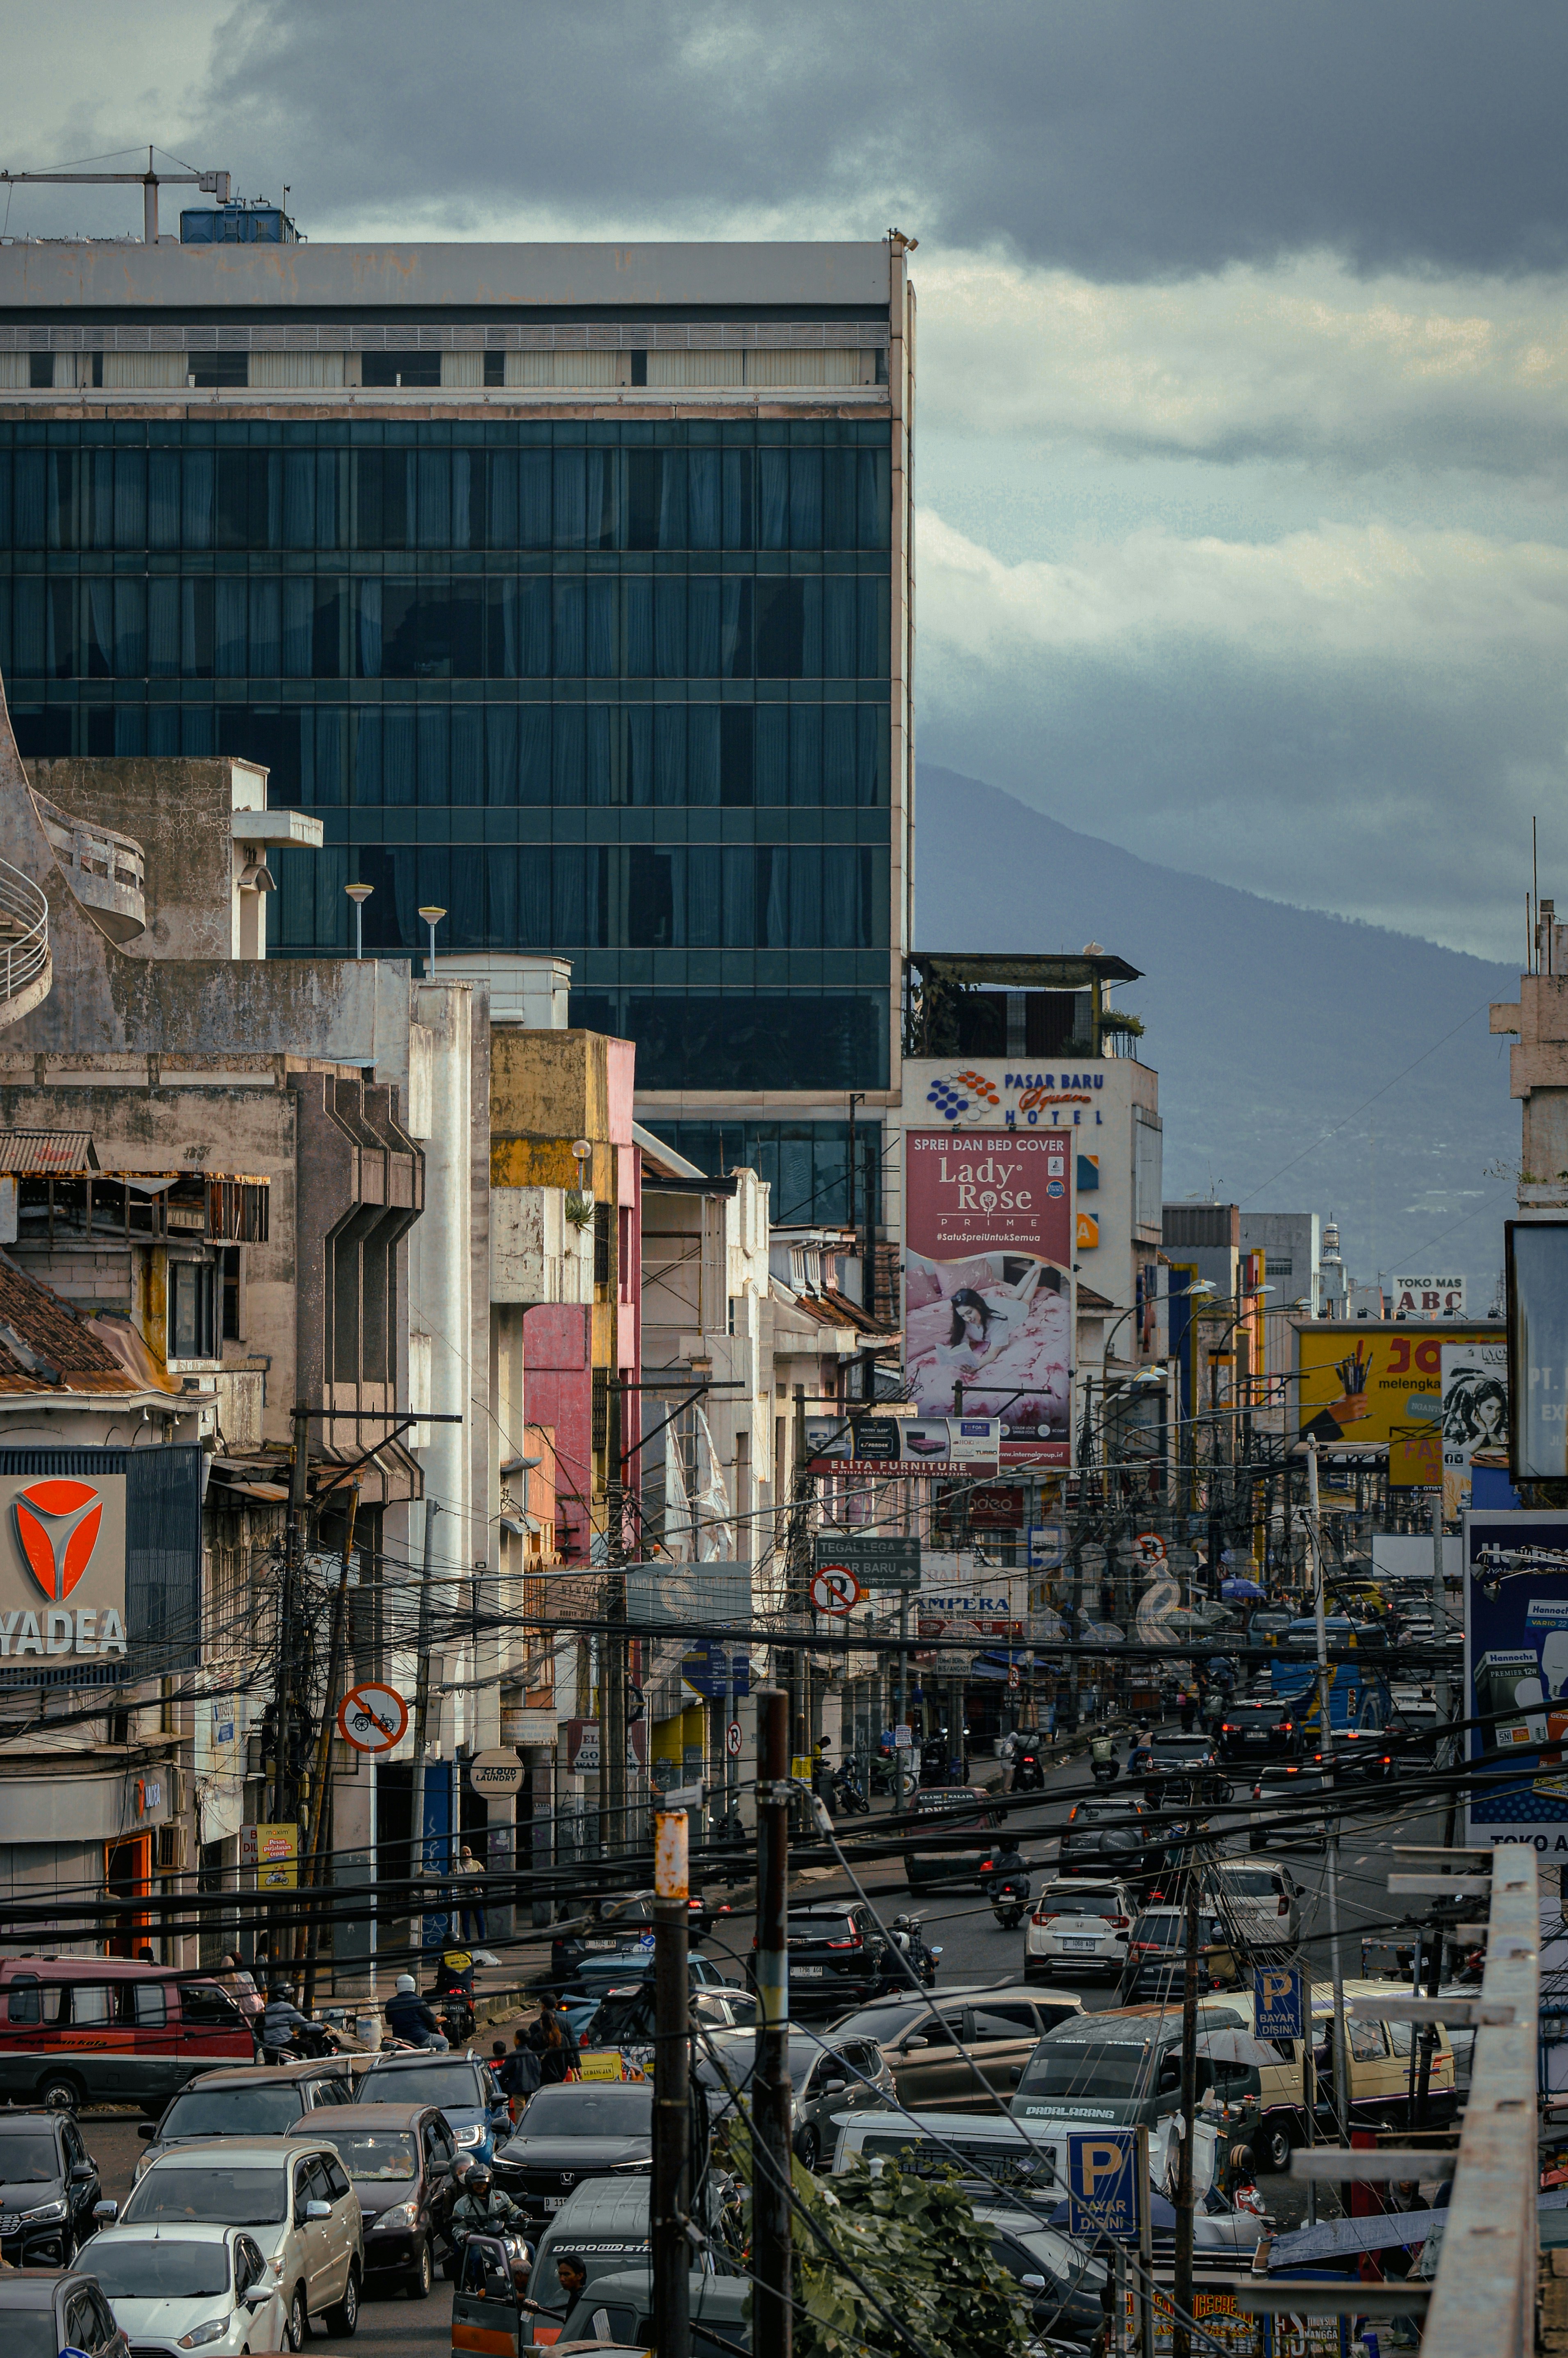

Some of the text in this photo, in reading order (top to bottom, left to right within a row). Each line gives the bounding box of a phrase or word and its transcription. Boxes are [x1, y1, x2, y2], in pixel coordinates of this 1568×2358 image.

[1005, 1074, 1103, 1089] PASAR BARU
[1019, 1084, 1091, 1114] Square
[1006, 1110, 1102, 1125] HOTEL
[915, 1139, 1064, 1152] SPREI DAN BED COVER
[939, 1157, 1015, 1189] Lady
[958, 1184, 1032, 1210] Rose
[937, 1233, 1041, 1242] #SatuSpreiUntukSemua
[1398, 1279, 1462, 1288] TOKO MAS
[1397, 1292, 1462, 1310] ABC
[831, 1461, 967, 1471] ELITA FURNITURE
[820, 1542, 895, 1553] TEGAL LEGA
[863, 1563, 896, 1573] BARU
[0, 1609, 127, 1654] YADEA
[1490, 1653, 1533, 1662] Hannochs
[1491, 1670, 1523, 1678] PREMIER
[1499, 1732, 1511, 1741] SNI
[145, 1783, 160, 1808] YADEA
[1259, 2014, 1295, 2023] BAYAR
[1262, 2025, 1293, 2035] DISINI
[1026, 2106, 1115, 2119] PADALARANG
[1082, 2142, 1123, 2195] P
[1077, 2200, 1127, 2213] BAYAR
